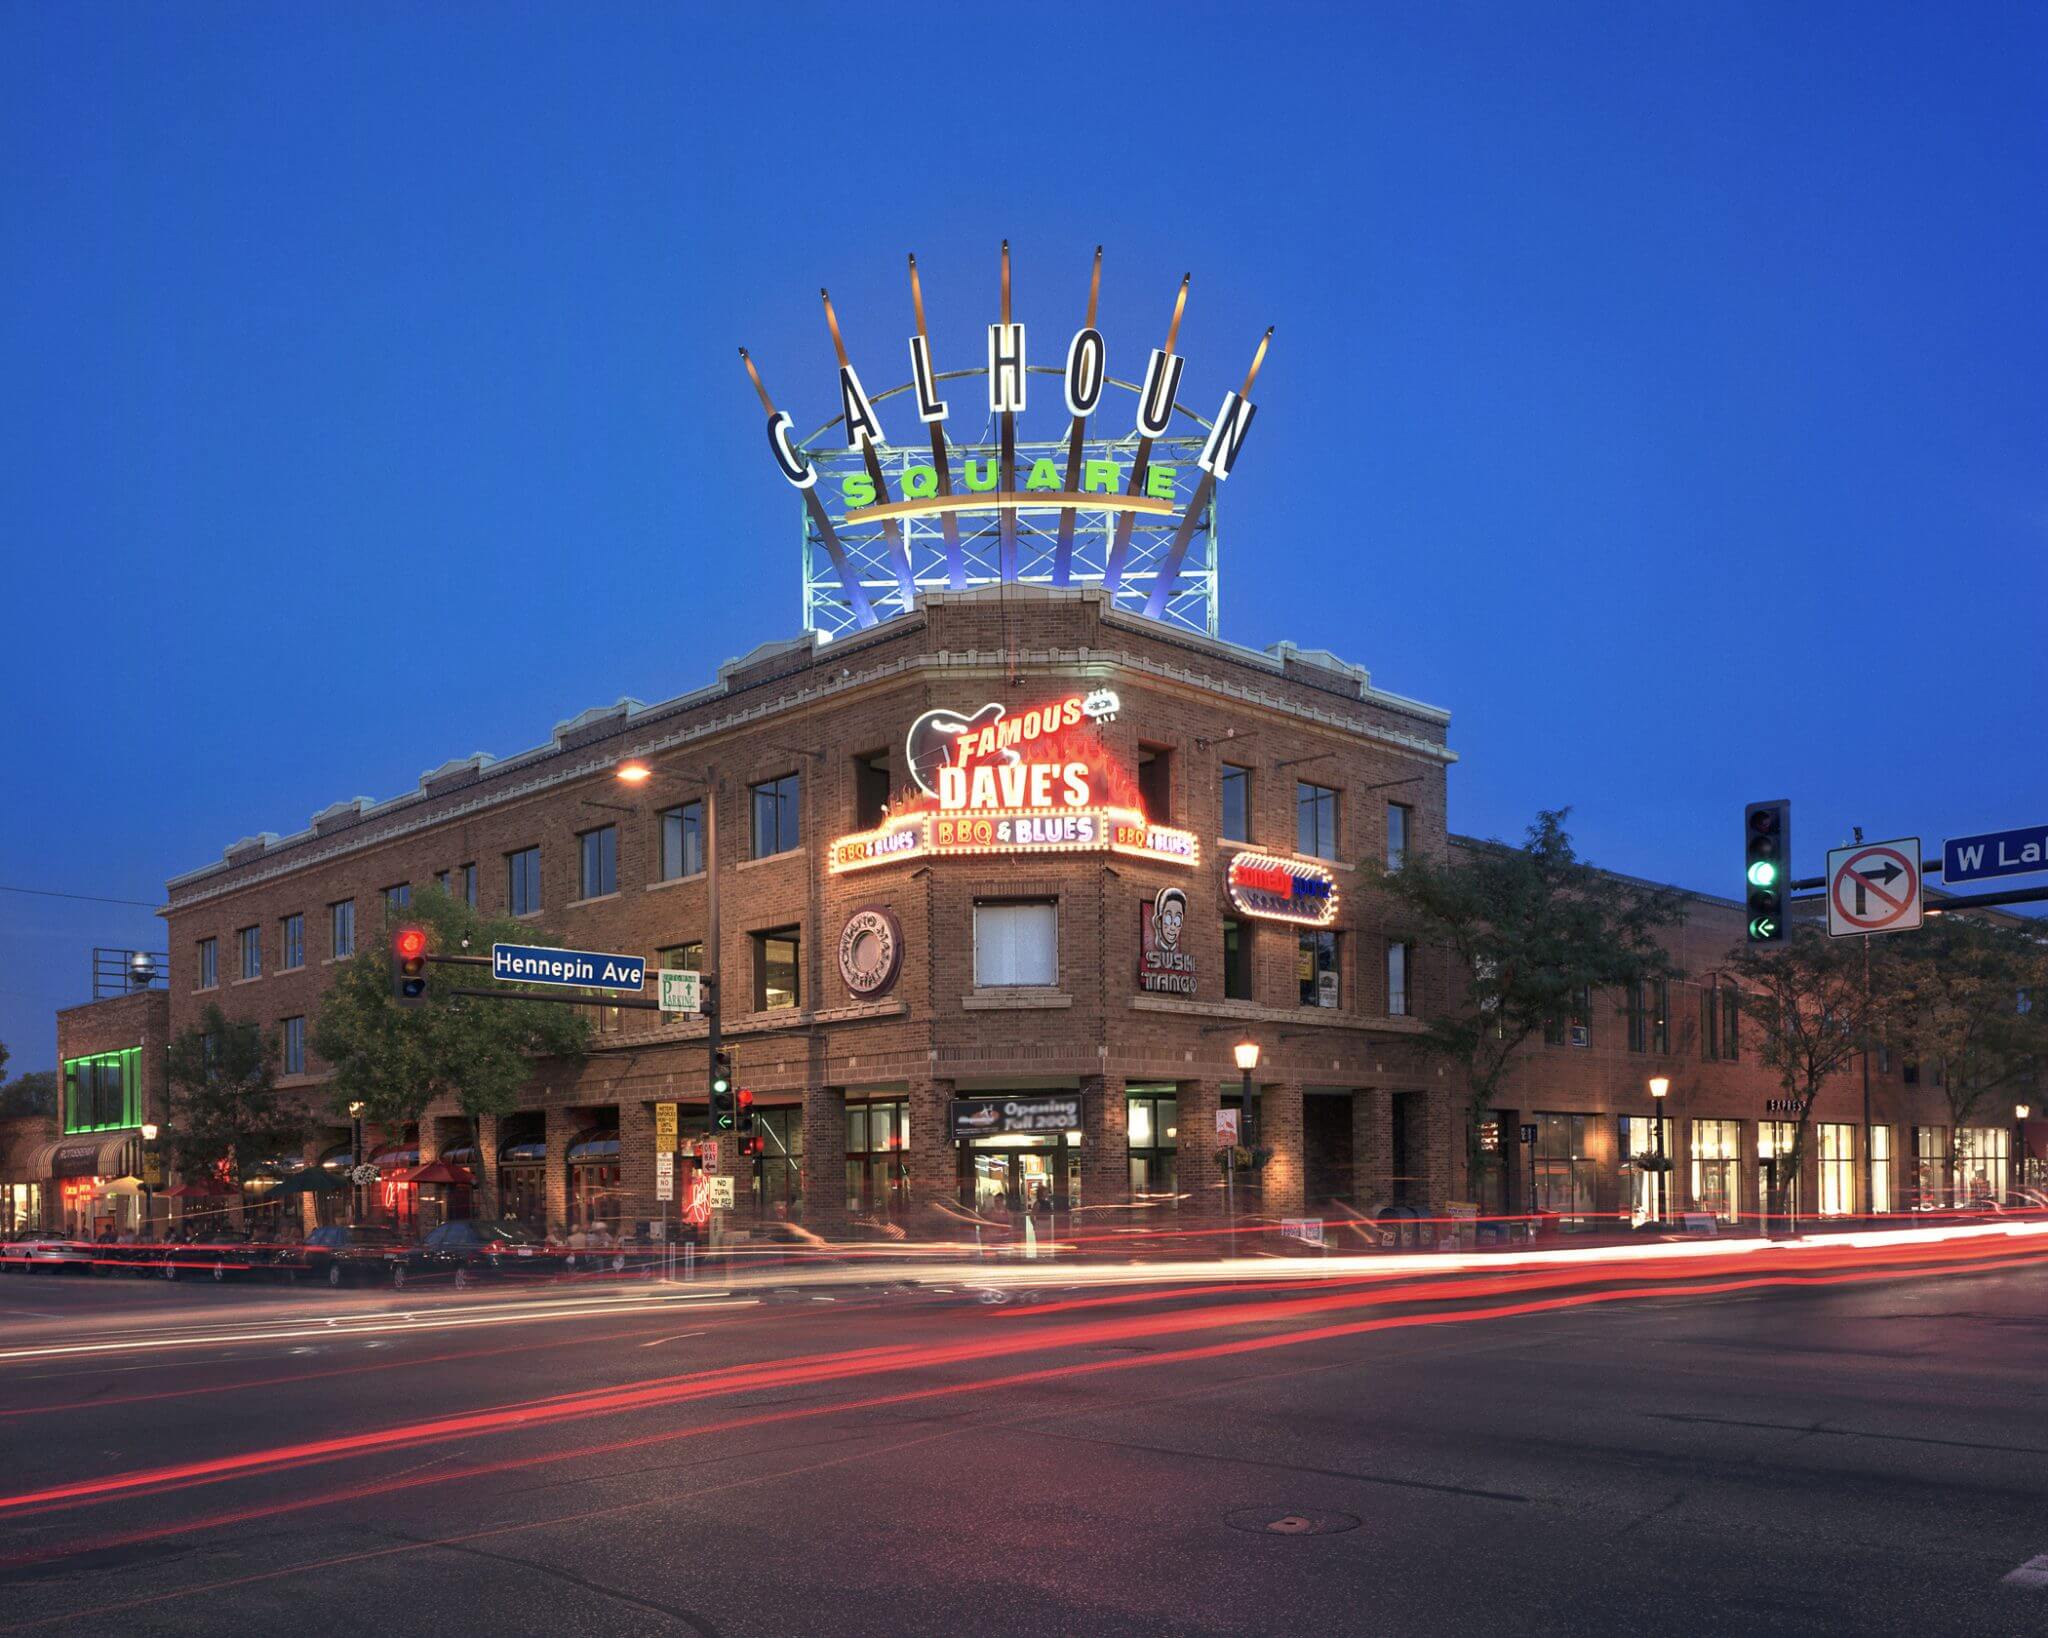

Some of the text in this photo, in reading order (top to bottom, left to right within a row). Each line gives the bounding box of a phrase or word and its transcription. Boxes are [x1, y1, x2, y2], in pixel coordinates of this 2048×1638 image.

[767, 324, 1257, 489] CALHOUN
[842, 458, 1178, 507] SQUARE
[957, 698, 1082, 768] FAMOUS
[939, 762, 1090, 810] DAVE'S
[938, 816, 1094, 846] BBQ & BLUES
[1118, 827, 1144, 849] BBQ
[839, 843, 865, 864] BBQ
[1957, 836, 2048, 872] W La
[496, 951, 641, 983] Hennepin Ave
[1146, 951, 1196, 973] SUSHI
[1141, 972, 1198, 993] TANGO
[1004, 1100, 1077, 1116] Opening
[704, 1143, 717, 1152] ONE
[704, 1153, 717, 1161] WAY
[711, 1197, 720, 1205] ON
[714, 1188, 729, 1196] TURN
